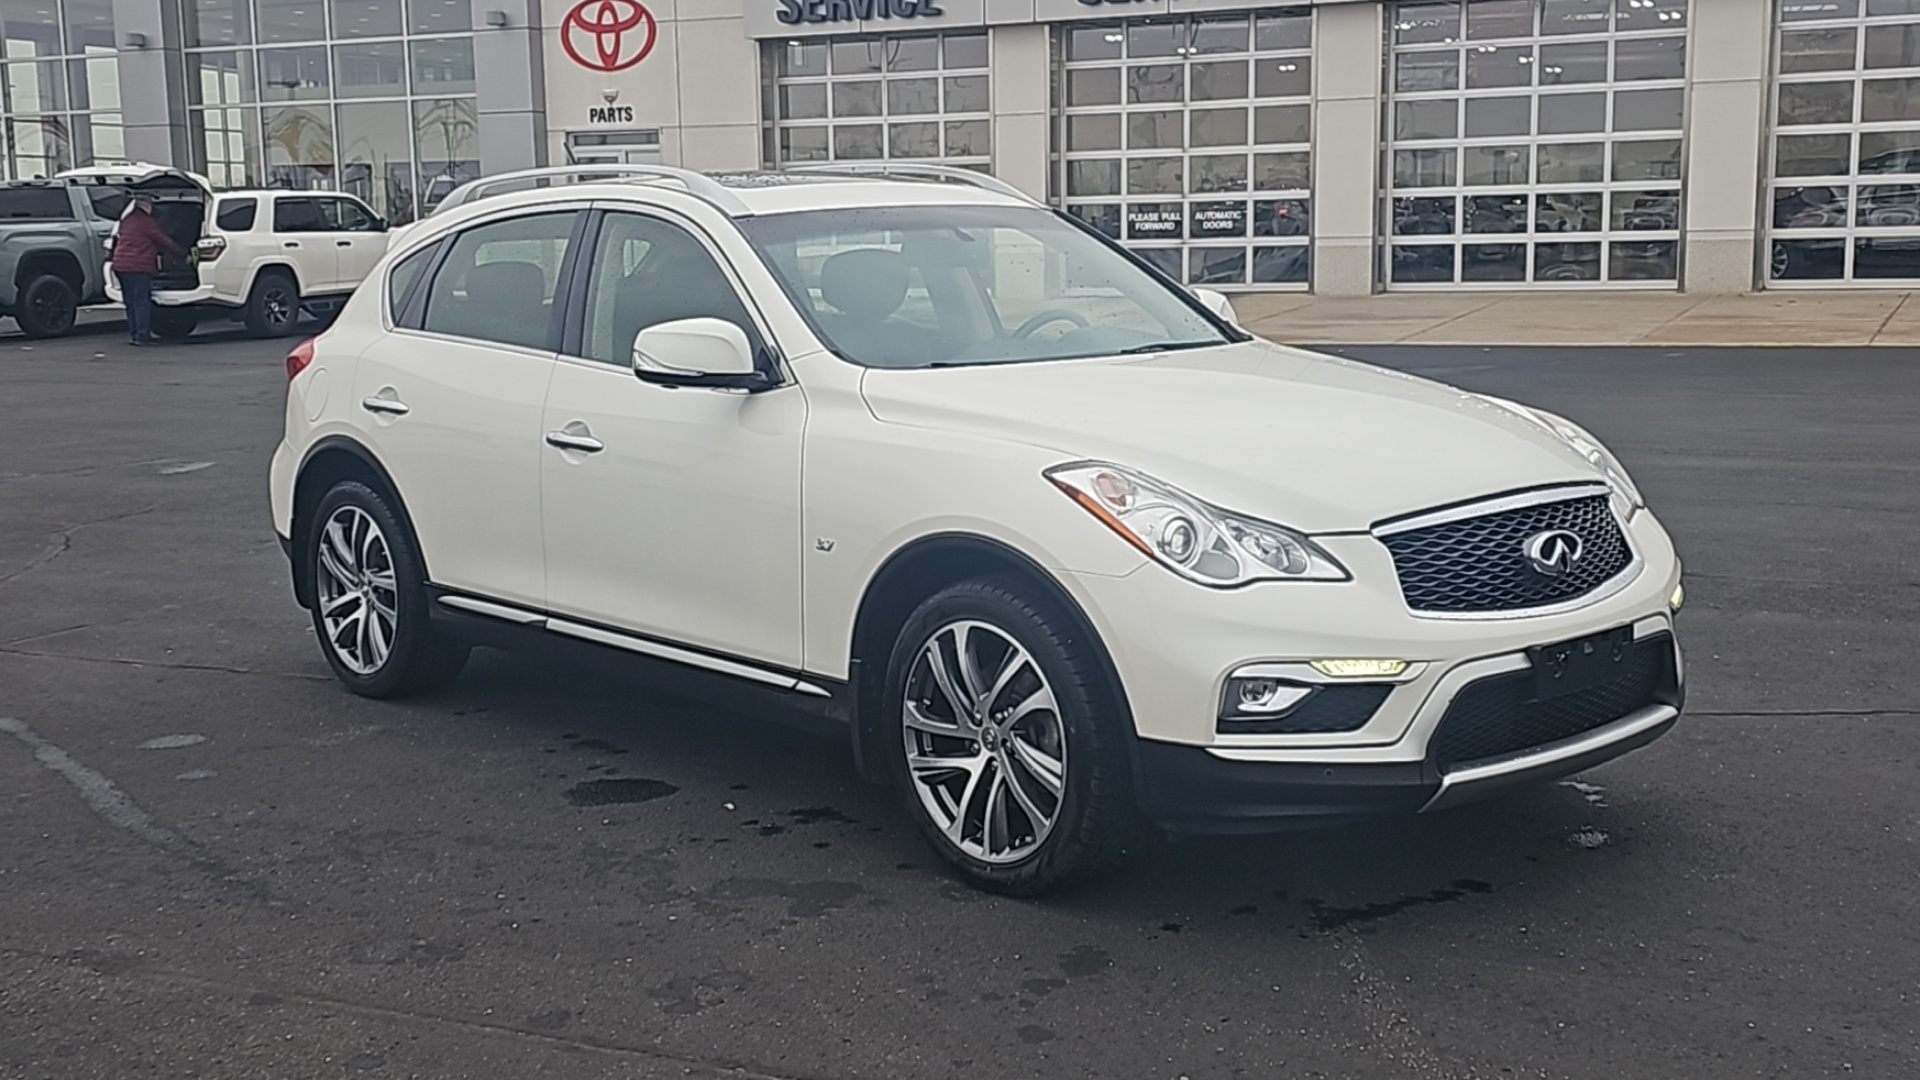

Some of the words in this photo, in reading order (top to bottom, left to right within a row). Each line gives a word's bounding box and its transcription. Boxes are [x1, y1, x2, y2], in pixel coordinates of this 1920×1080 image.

[589, 106, 633, 123] PARTS
[1128, 211, 1160, 221] PLEASE
[1161, 211, 1182, 221] PULL
[1195, 210, 1242, 220] AUTOMATIC
[1135, 221, 1176, 231] FORWARD
[1202, 220, 1234, 230] DOORS
